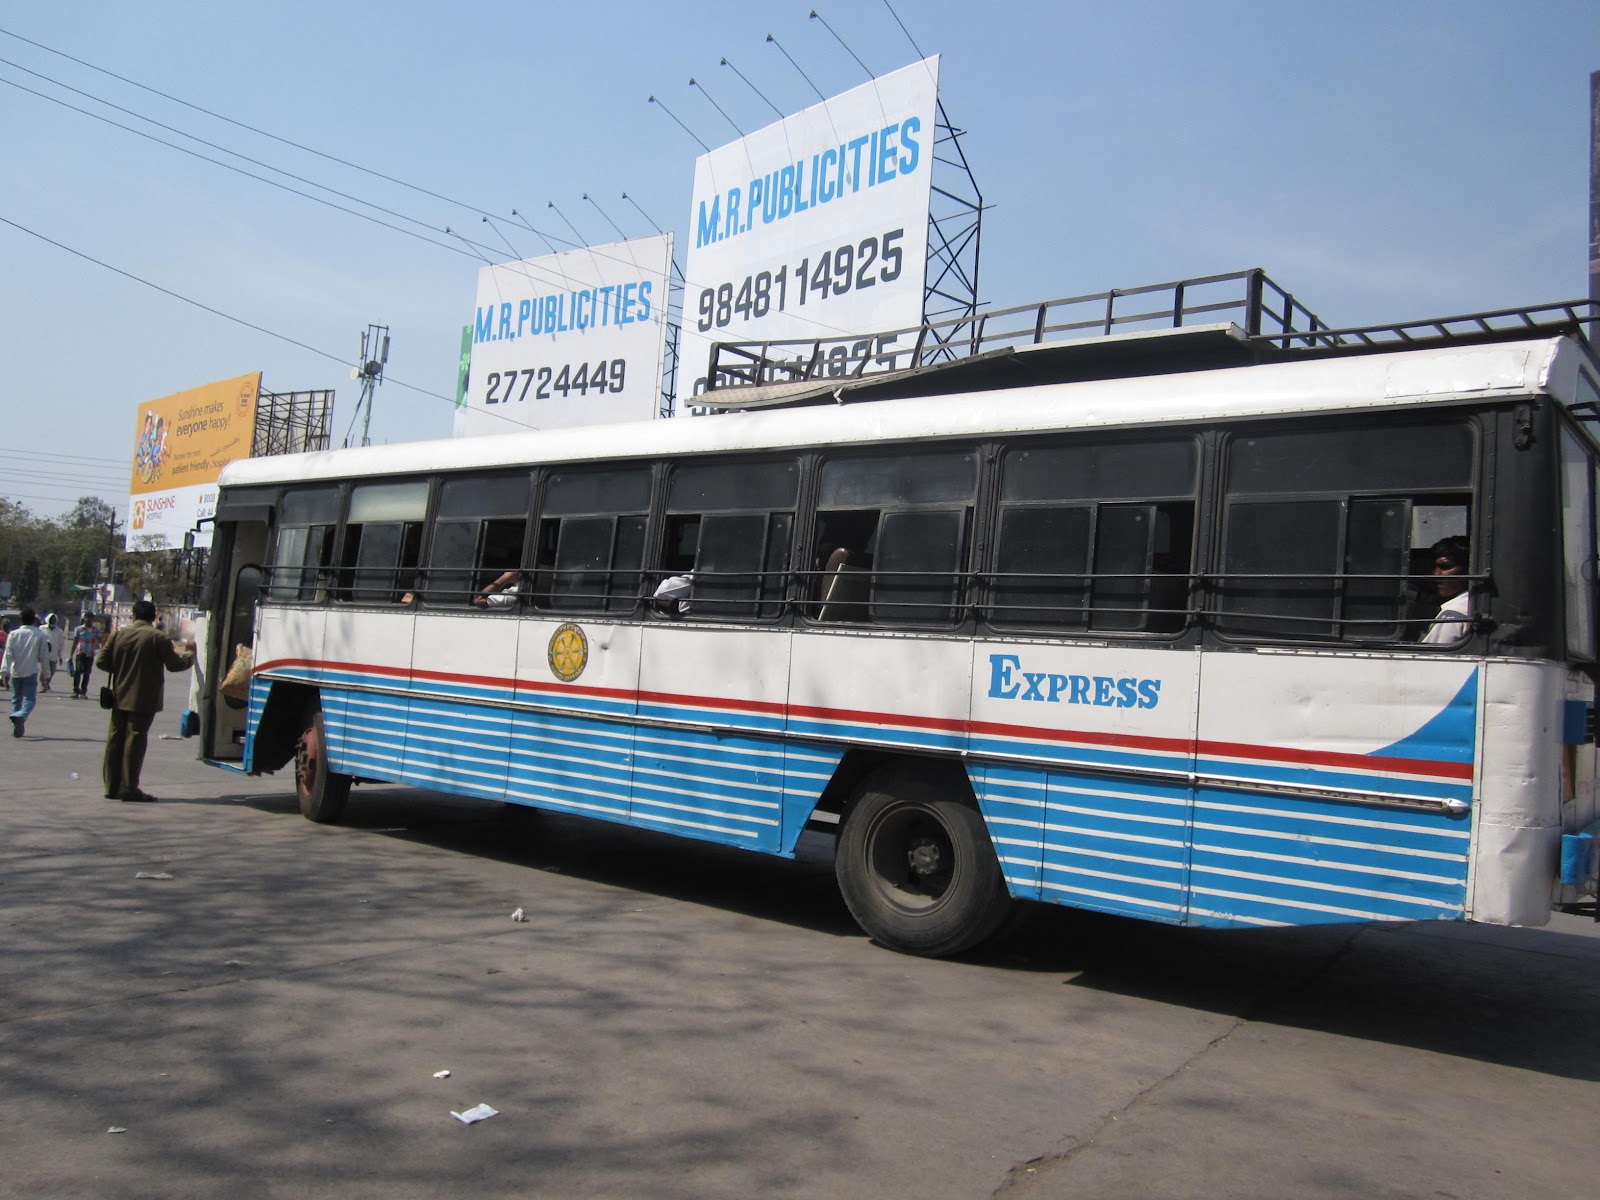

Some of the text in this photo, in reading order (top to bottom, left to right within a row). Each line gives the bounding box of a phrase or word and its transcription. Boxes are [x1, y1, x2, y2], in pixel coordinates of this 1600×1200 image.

[696, 115, 921, 249] M.R.PUBLICITIES
[697, 227, 905, 333] 9848114925
[473, 280, 653, 344] M.R.PUBLICITIES
[485, 358, 626, 405] 27724449
[176, 413, 232, 437] everyone happy!
[178, 405, 203, 421] Sunshine
[204, 400, 224, 415] makes
[172, 463, 189, 477] patient
[190, 459, 209, 472] friendly
[147, 495, 176, 512] SUNSHINE
[988, 653, 1162, 710] EXPRESS
